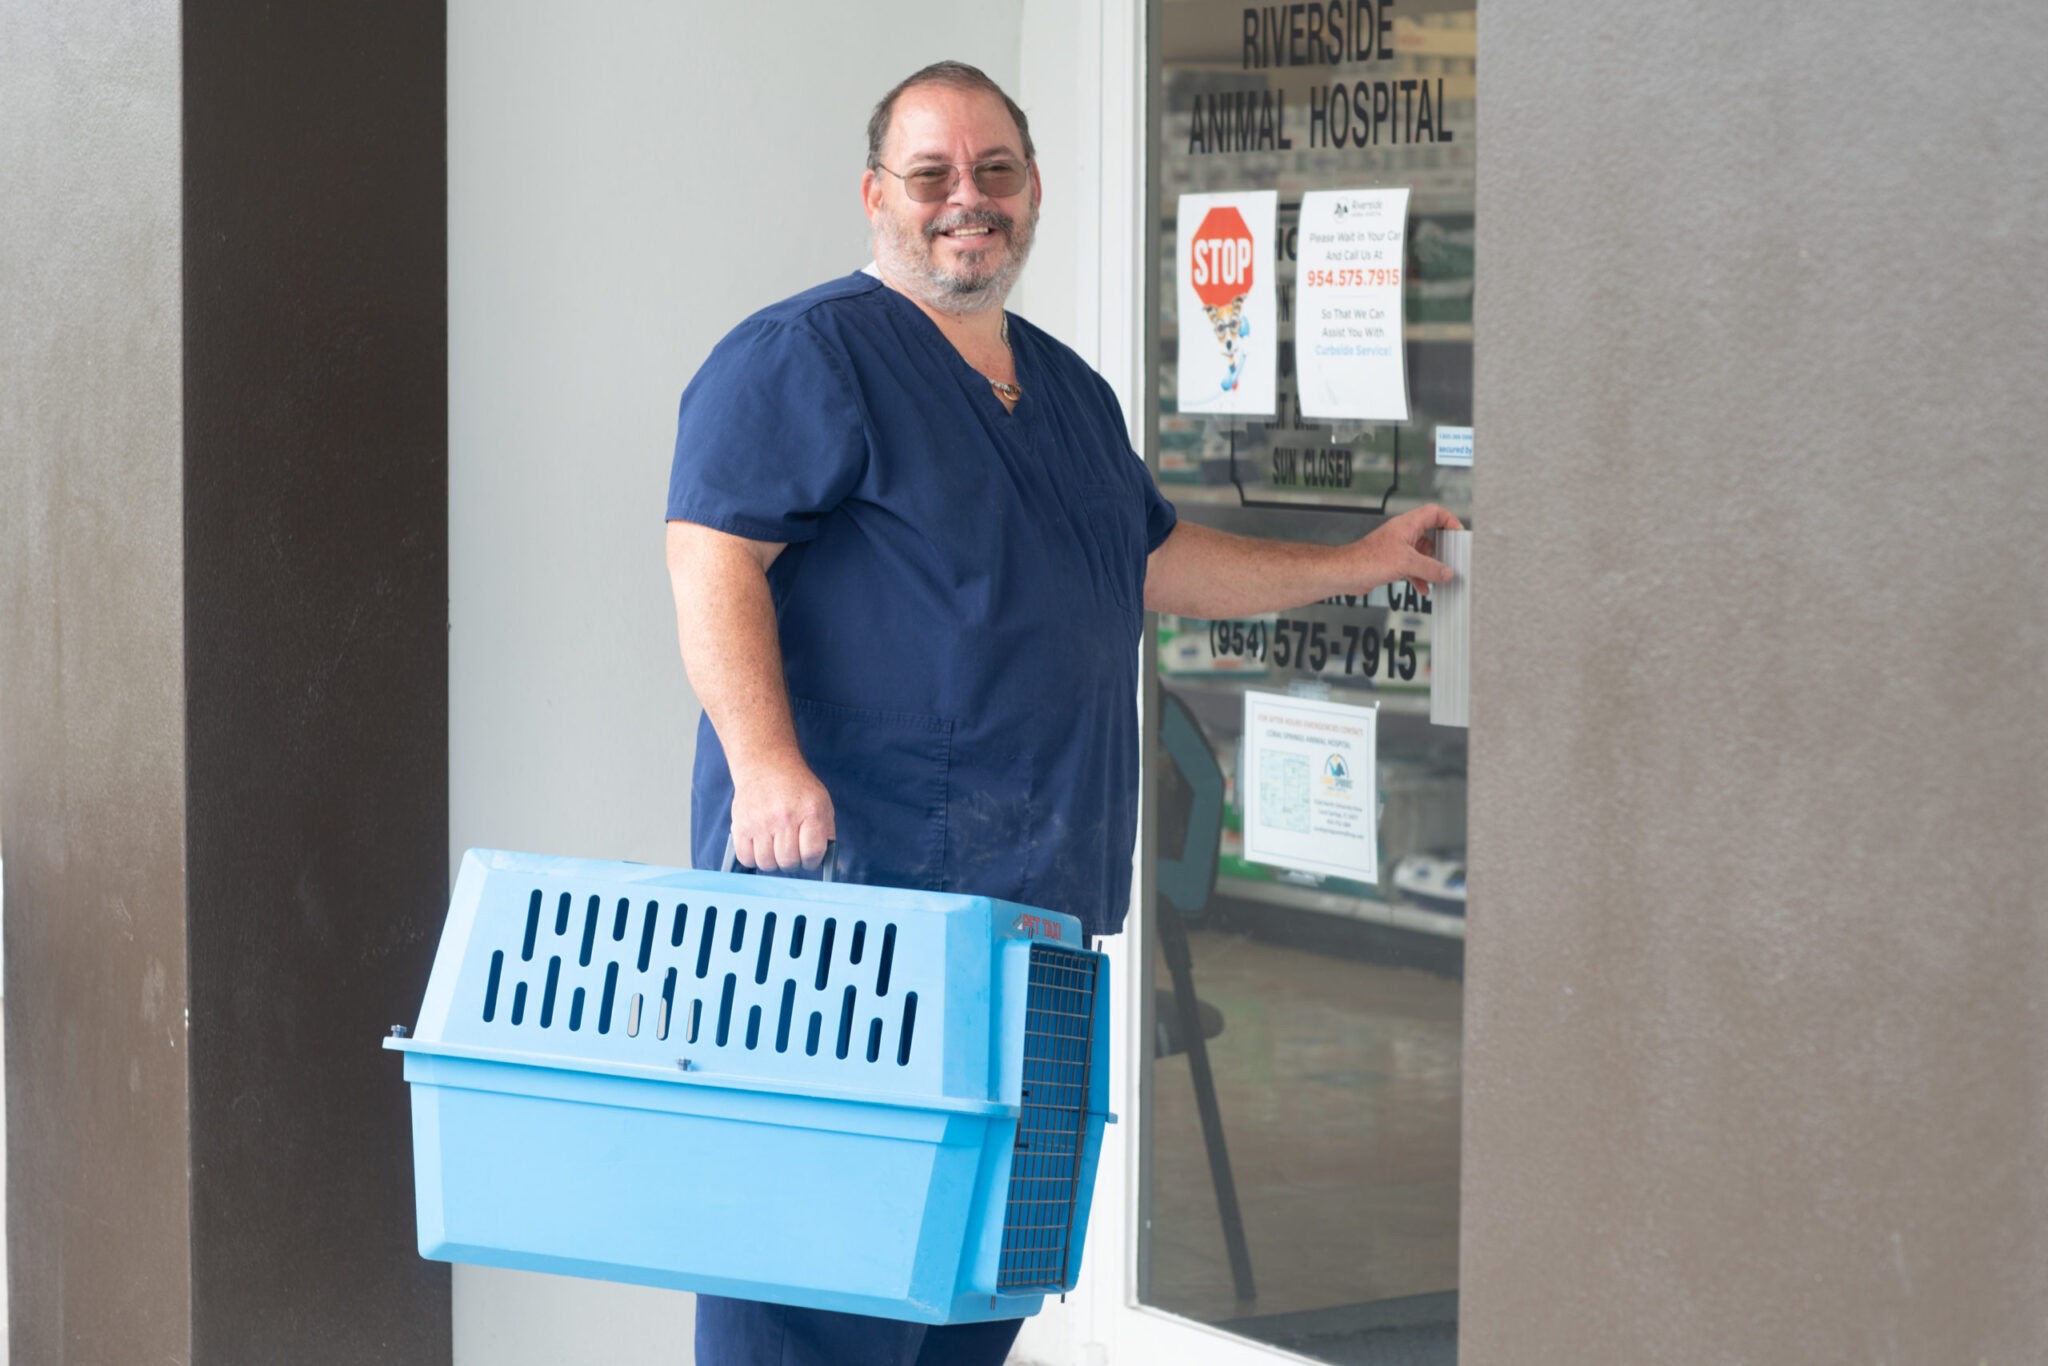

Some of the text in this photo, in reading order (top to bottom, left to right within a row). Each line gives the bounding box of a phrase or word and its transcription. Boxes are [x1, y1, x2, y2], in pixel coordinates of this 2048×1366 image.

[1243, 0, 1393, 69] RIVERSIDE
[1189, 78, 1453, 155] ANIMAL HOSPITAL
[1309, 232, 1335, 243] Please
[1338, 231, 1355, 242] Wait
[1368, 231, 1386, 242] Your
[1387, 230, 1401, 241] Car
[1193, 238, 1251, 286] STOP
[1326, 250, 1383, 260] And Call Us At
[1307, 268, 1400, 287] 954.575.7915
[1321, 308, 1386, 319] So That We Can
[1321, 328, 1385, 338] Assist You With
[1315, 345, 1353, 356] Curbside
[1273, 446, 1353, 488] SUN CLOSED
[1209, 618, 1417, 681] (954) 575-7915
[1022, 913, 1062, 940] PET TAXI
